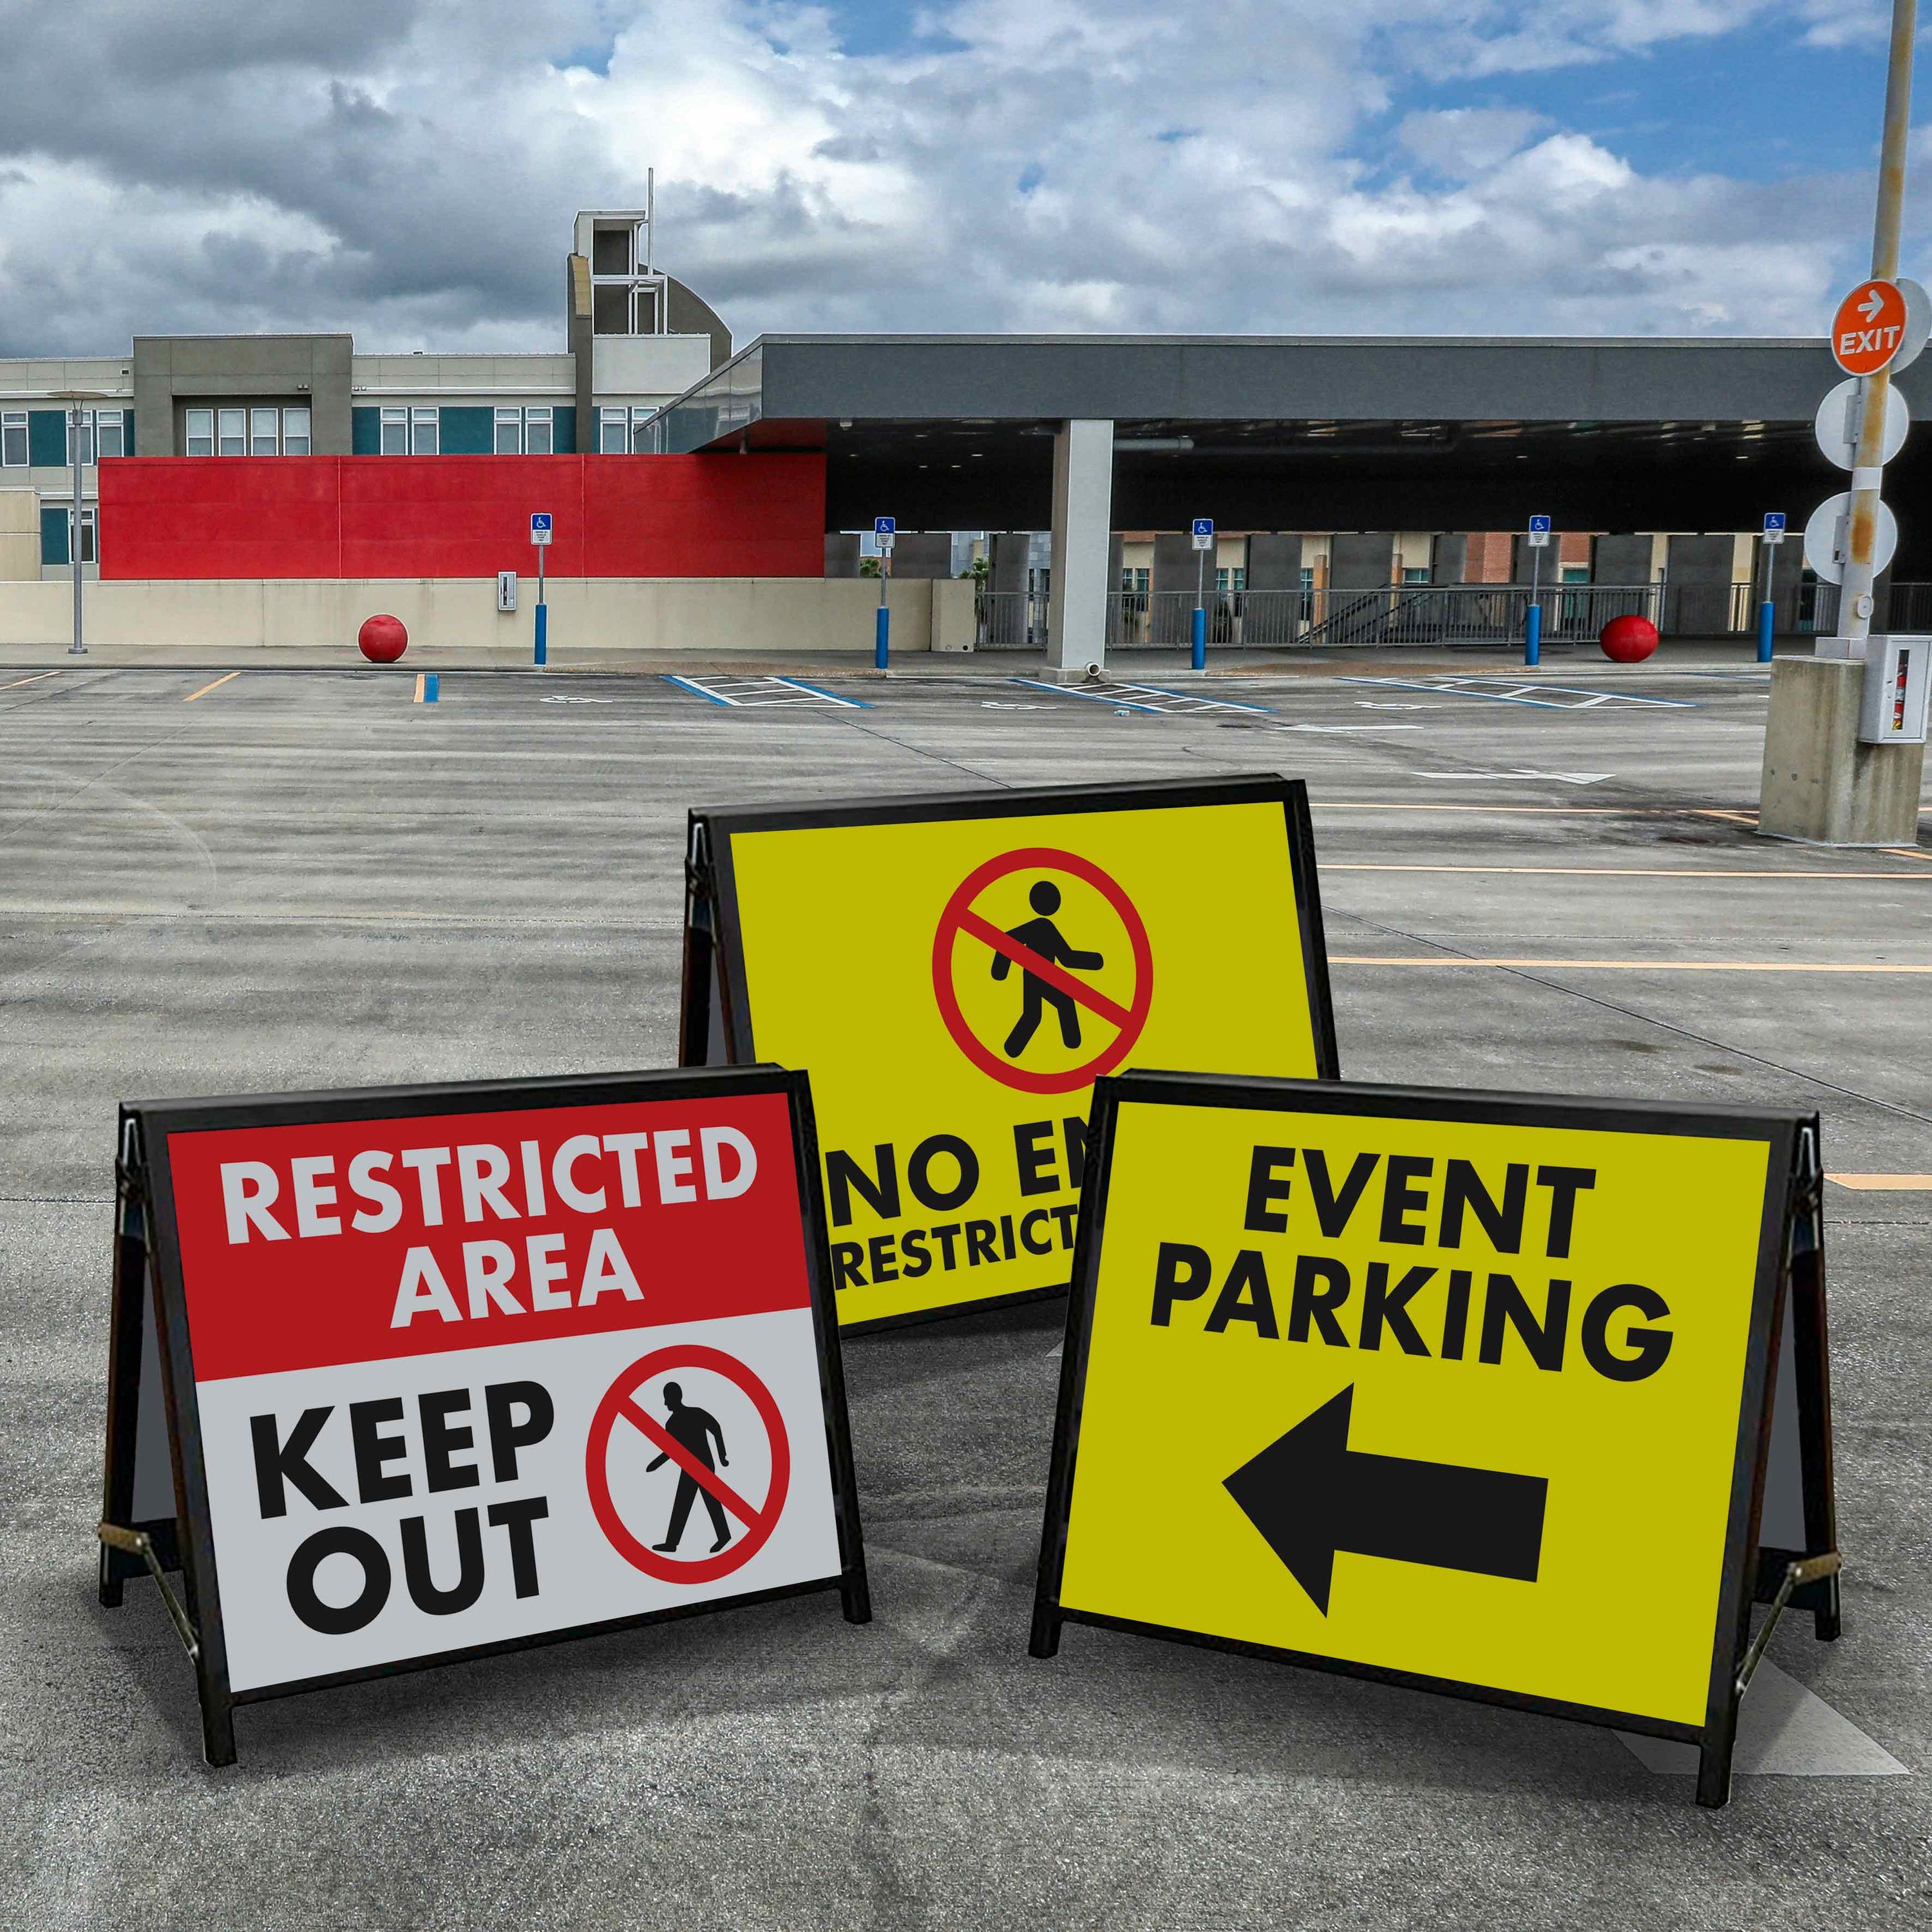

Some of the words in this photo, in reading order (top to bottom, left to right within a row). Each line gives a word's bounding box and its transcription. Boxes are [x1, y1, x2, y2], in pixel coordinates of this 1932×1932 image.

[1840, 326, 1900, 355] EXIT
[220, 1126, 757, 1245] RESTRICTED
[825, 1133, 980, 1227] NO
[1244, 1145, 1597, 1259] EVENT
[390, 1228, 645, 1329] AREA
[831, 1204, 1078, 1291] RESTRICT
[1150, 1242, 1674, 1382] PARKING
[249, 1380, 554, 1520] KEEP
[286, 1495, 549, 1635] OUT
